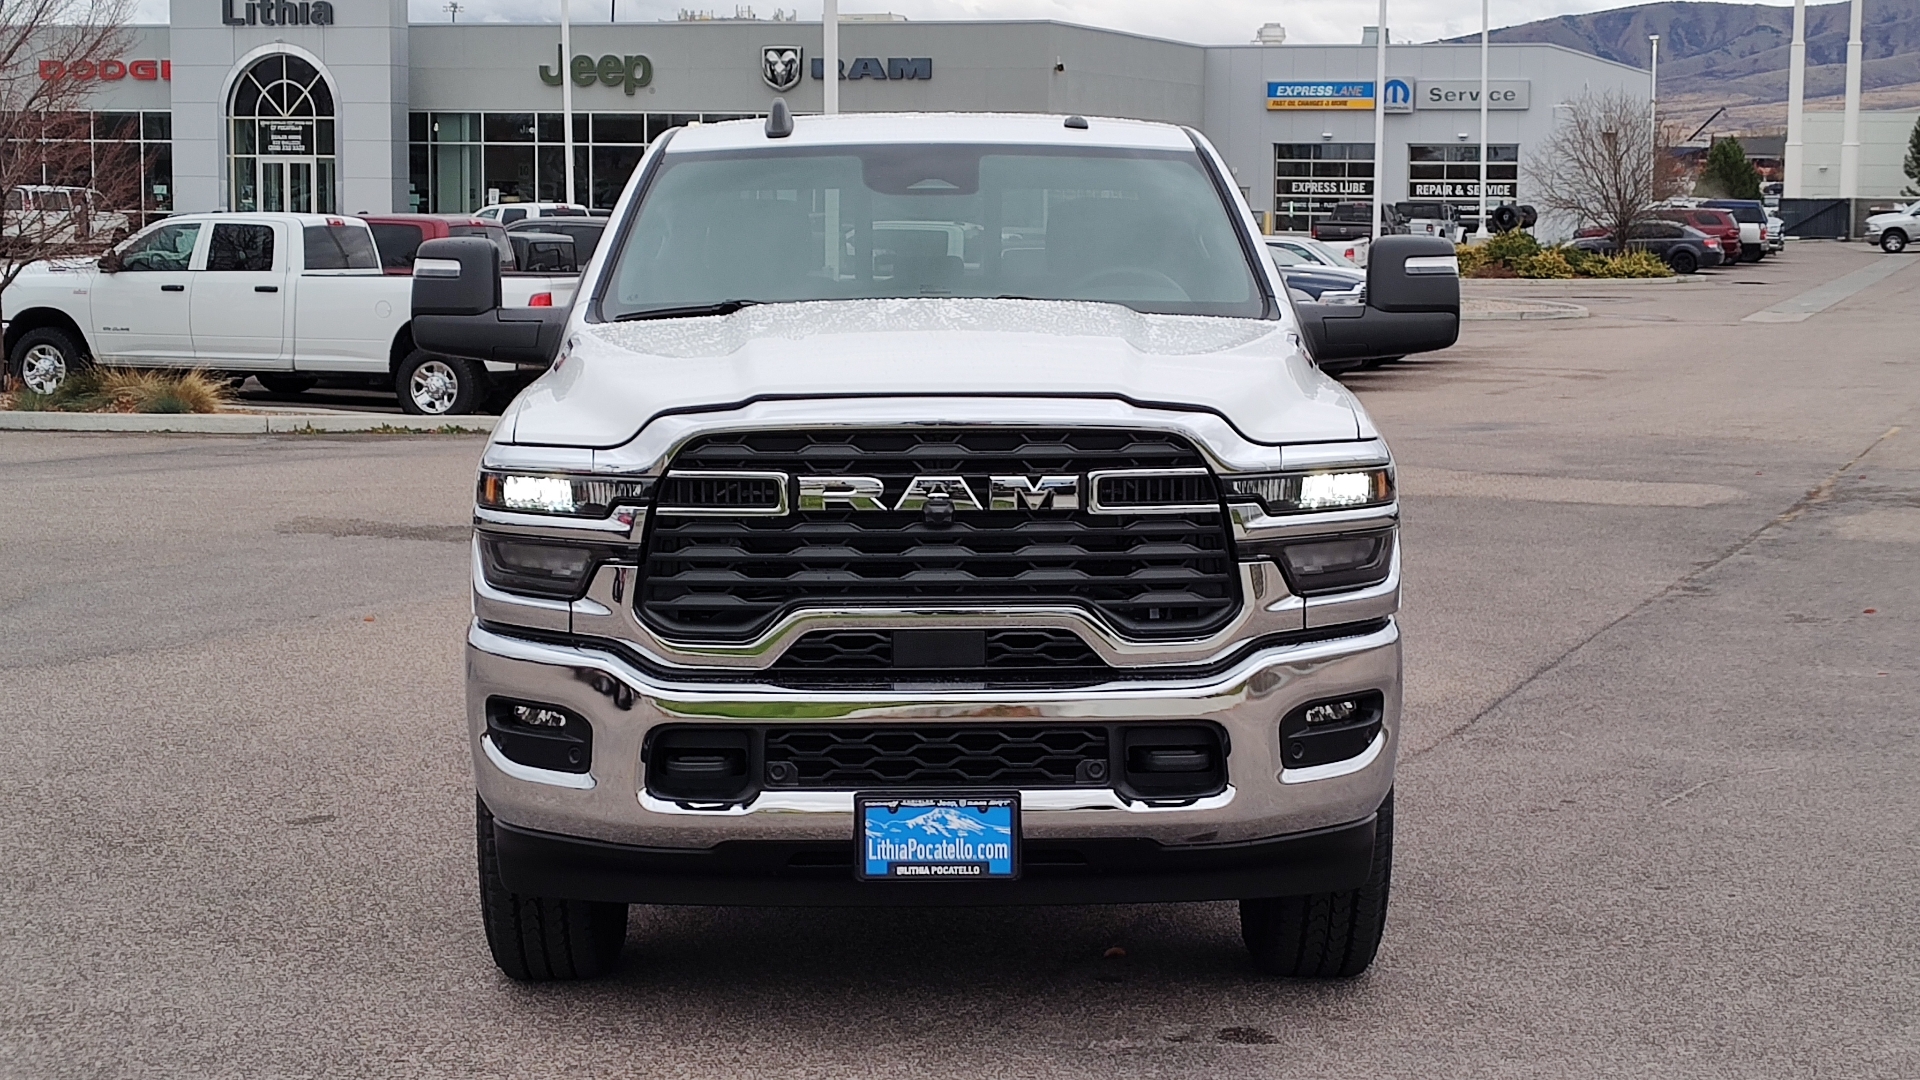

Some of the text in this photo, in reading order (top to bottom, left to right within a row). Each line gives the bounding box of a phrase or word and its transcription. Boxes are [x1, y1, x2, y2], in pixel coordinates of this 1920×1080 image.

[222, 0, 334, 26] Lithia
[539, 43, 653, 96] Jeep
[811, 57, 932, 81] RAM
[1429, 87, 1516, 102] Servce
[1291, 182, 1366, 193] EXPRESS LUBE
[1416, 184, 1511, 196] REPAIR & SEVICE
[797, 475, 1080, 511] RAM
[868, 838, 1008, 860] LithiaPocatello.com
[904, 866, 980, 875] LITHIA POCATELLO
